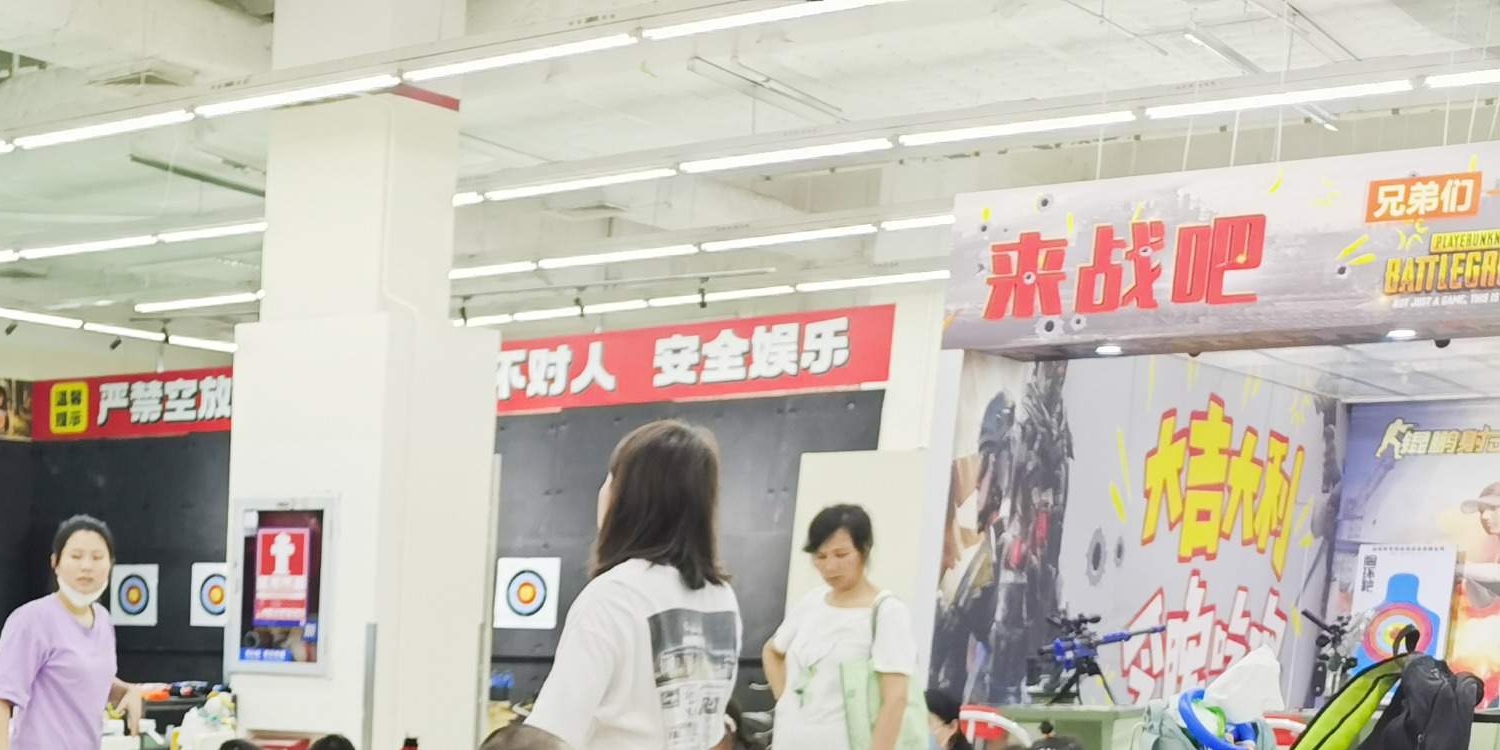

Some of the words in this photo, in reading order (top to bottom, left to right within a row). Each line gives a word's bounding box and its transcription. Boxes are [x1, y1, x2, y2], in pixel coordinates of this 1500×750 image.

[1372, 178, 1476, 219] 兄弟们
[983, 213, 1267, 321] 来战吧
[1385, 250, 1500, 294] BATTLEGR
[652, 317, 851, 389] 安全娱乐
[97, 375, 234, 427] 严禁空放
[1141, 392, 1306, 583] 大吉大利
